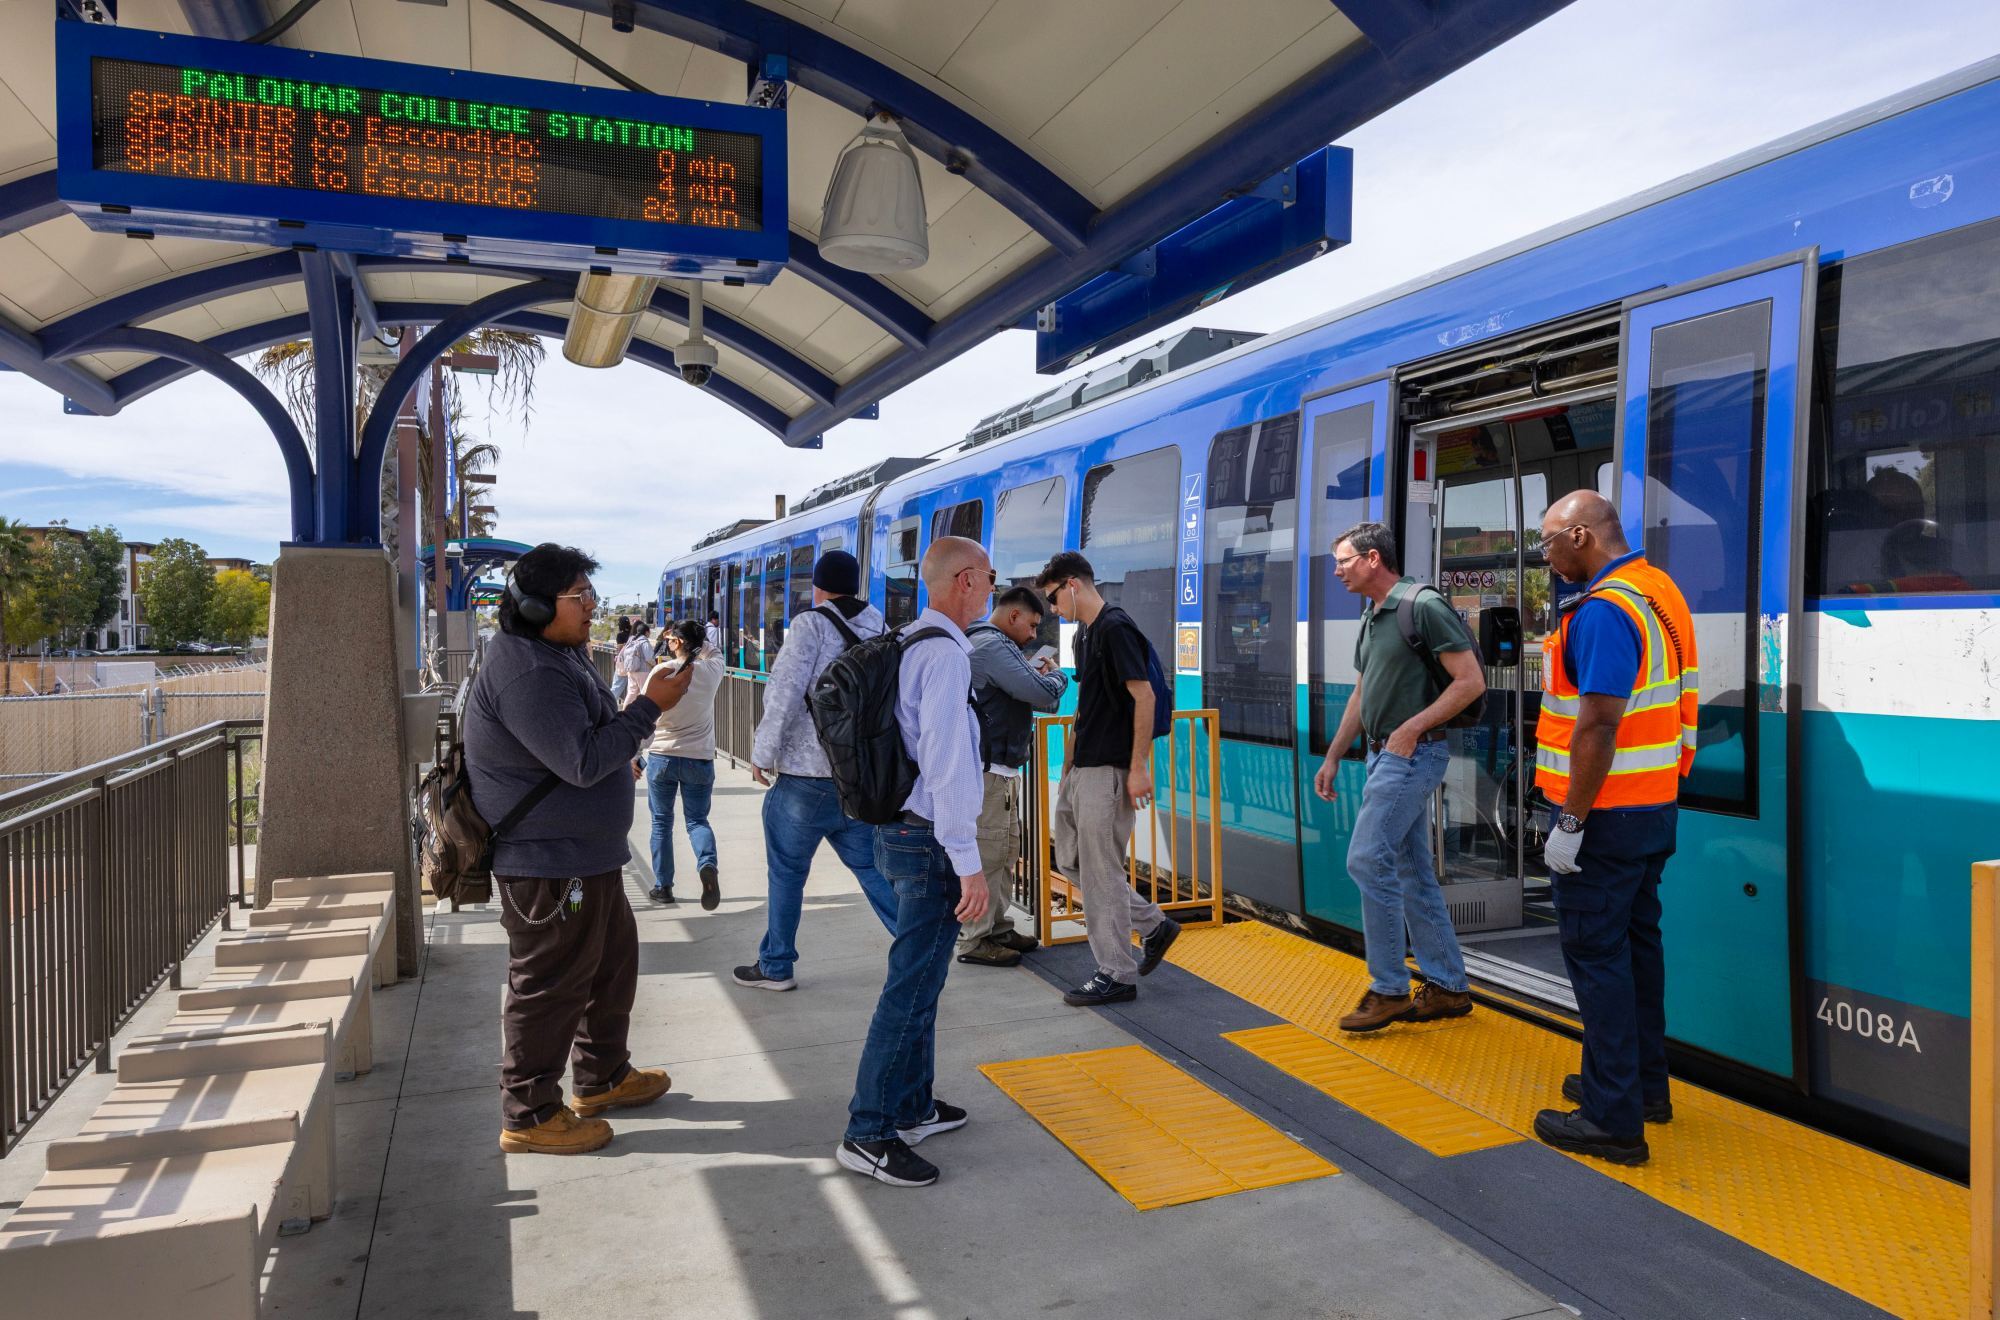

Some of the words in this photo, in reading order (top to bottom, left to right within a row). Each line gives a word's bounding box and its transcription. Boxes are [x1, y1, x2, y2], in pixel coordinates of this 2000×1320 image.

[128, 90, 297, 132] SPRINTER
[313, 111, 351, 139] to
[658, 150, 676, 174] 0
[689, 156, 737, 181] min
[182, 69, 361, 114] PALOMAR
[380, 93, 530, 134] COLLEGE
[548, 113, 694, 152] STATION
[126, 118, 294, 158] SPRINTER
[310, 137, 348, 164] to
[658, 175, 676, 198] 4
[689, 182, 737, 205] min
[126, 145, 294, 184] SPRINTER
[312, 163, 348, 190] to
[643, 196, 679, 223] 26
[691, 203, 740, 229] min
[1816, 997, 1922, 1053] 4008A
